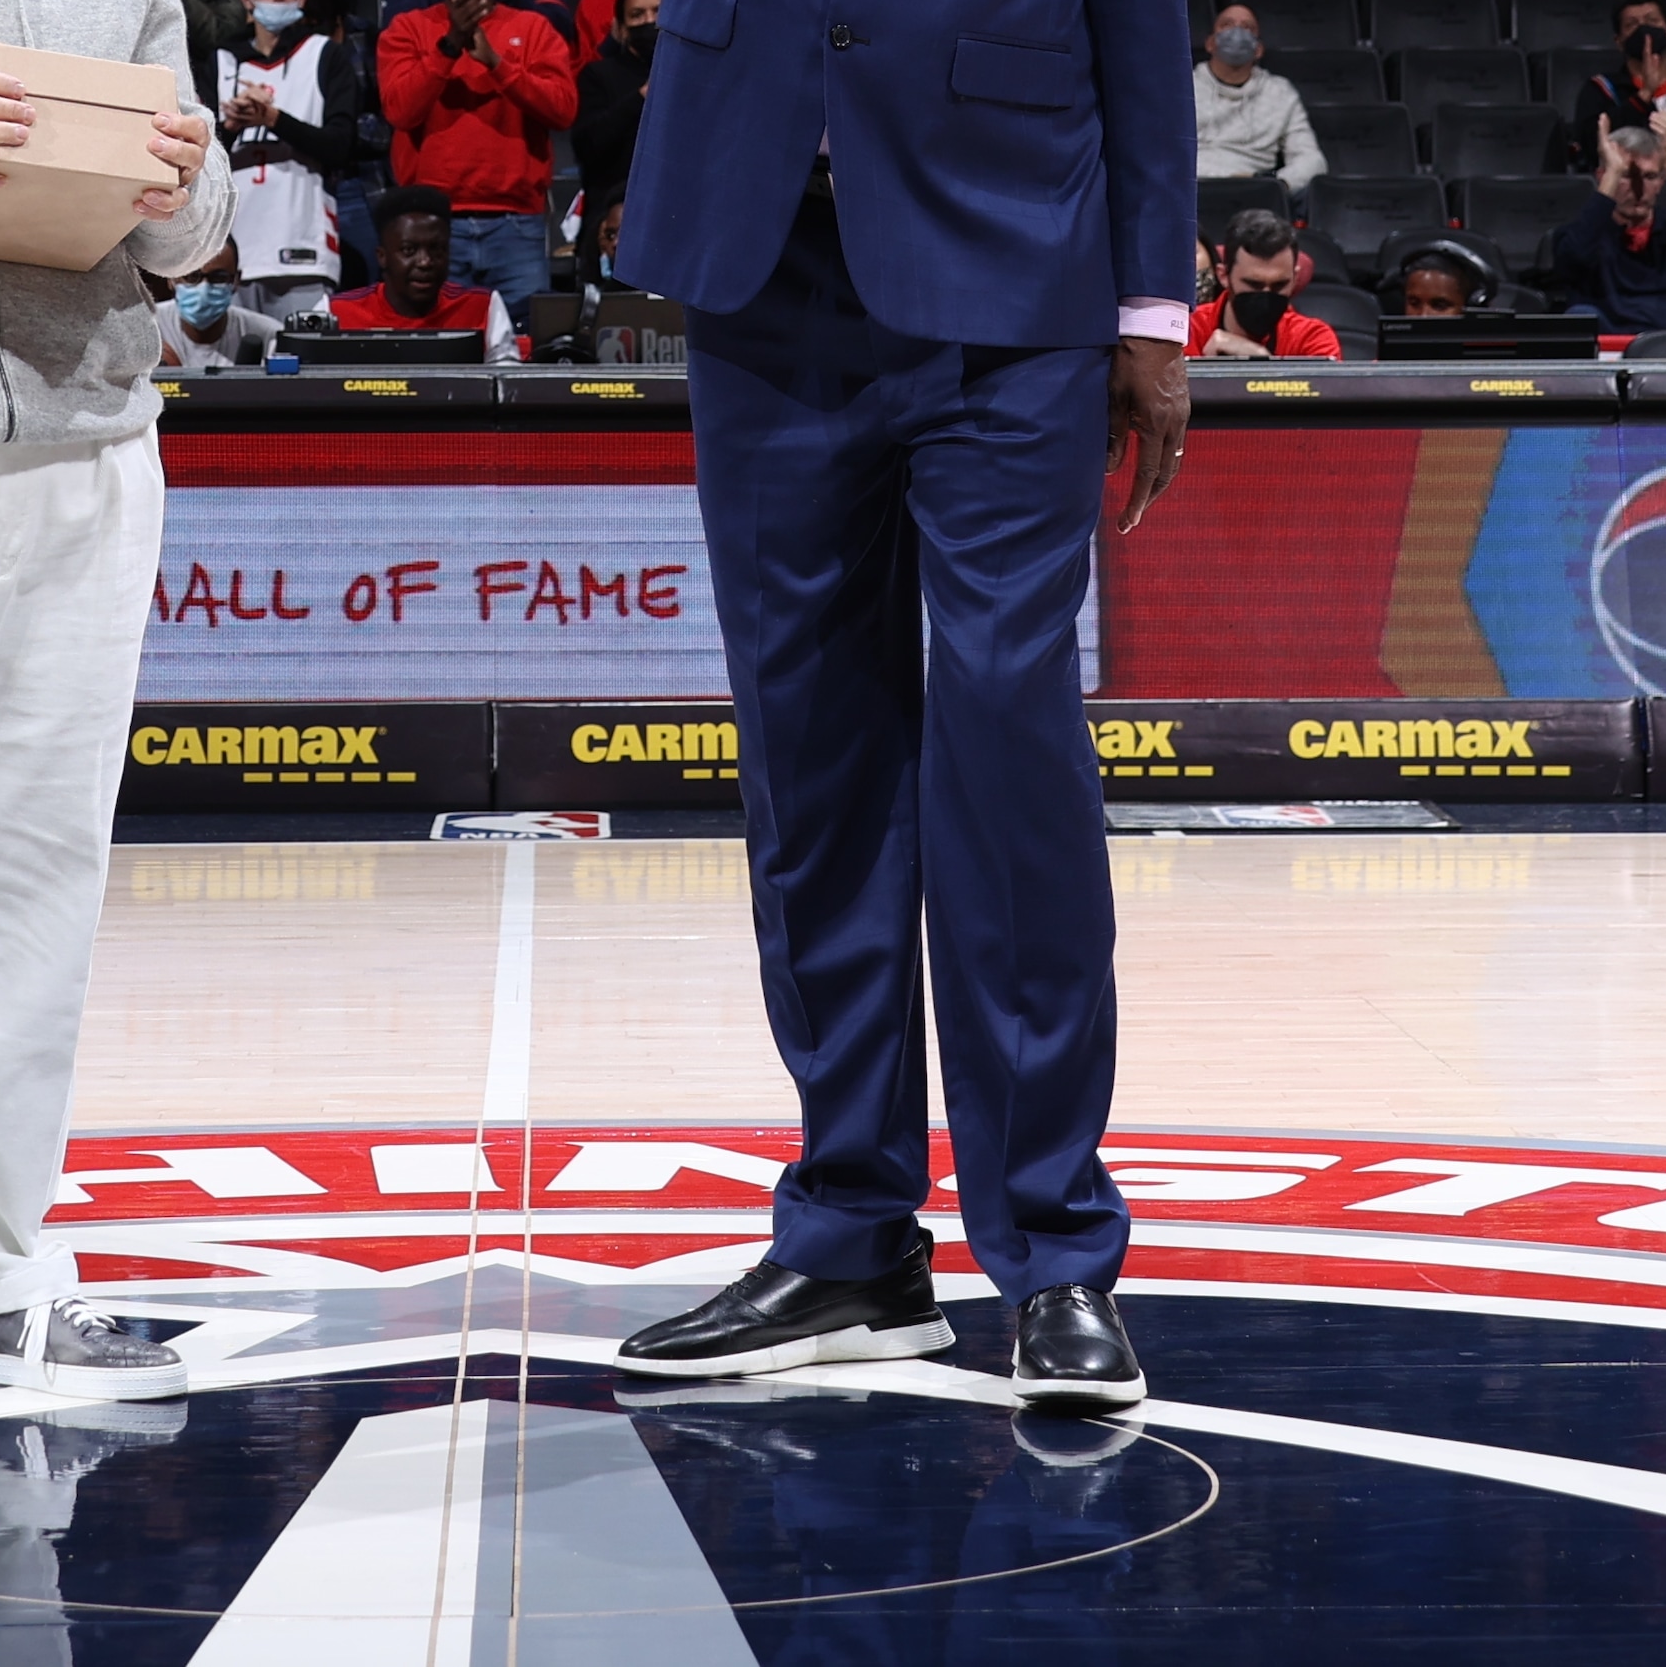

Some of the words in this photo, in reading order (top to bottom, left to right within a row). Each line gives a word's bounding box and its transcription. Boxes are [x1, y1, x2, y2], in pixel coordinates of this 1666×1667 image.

[342, 560, 442, 621] OF
[473, 558, 689, 626] FAME
[571, 721, 740, 763] CARm
